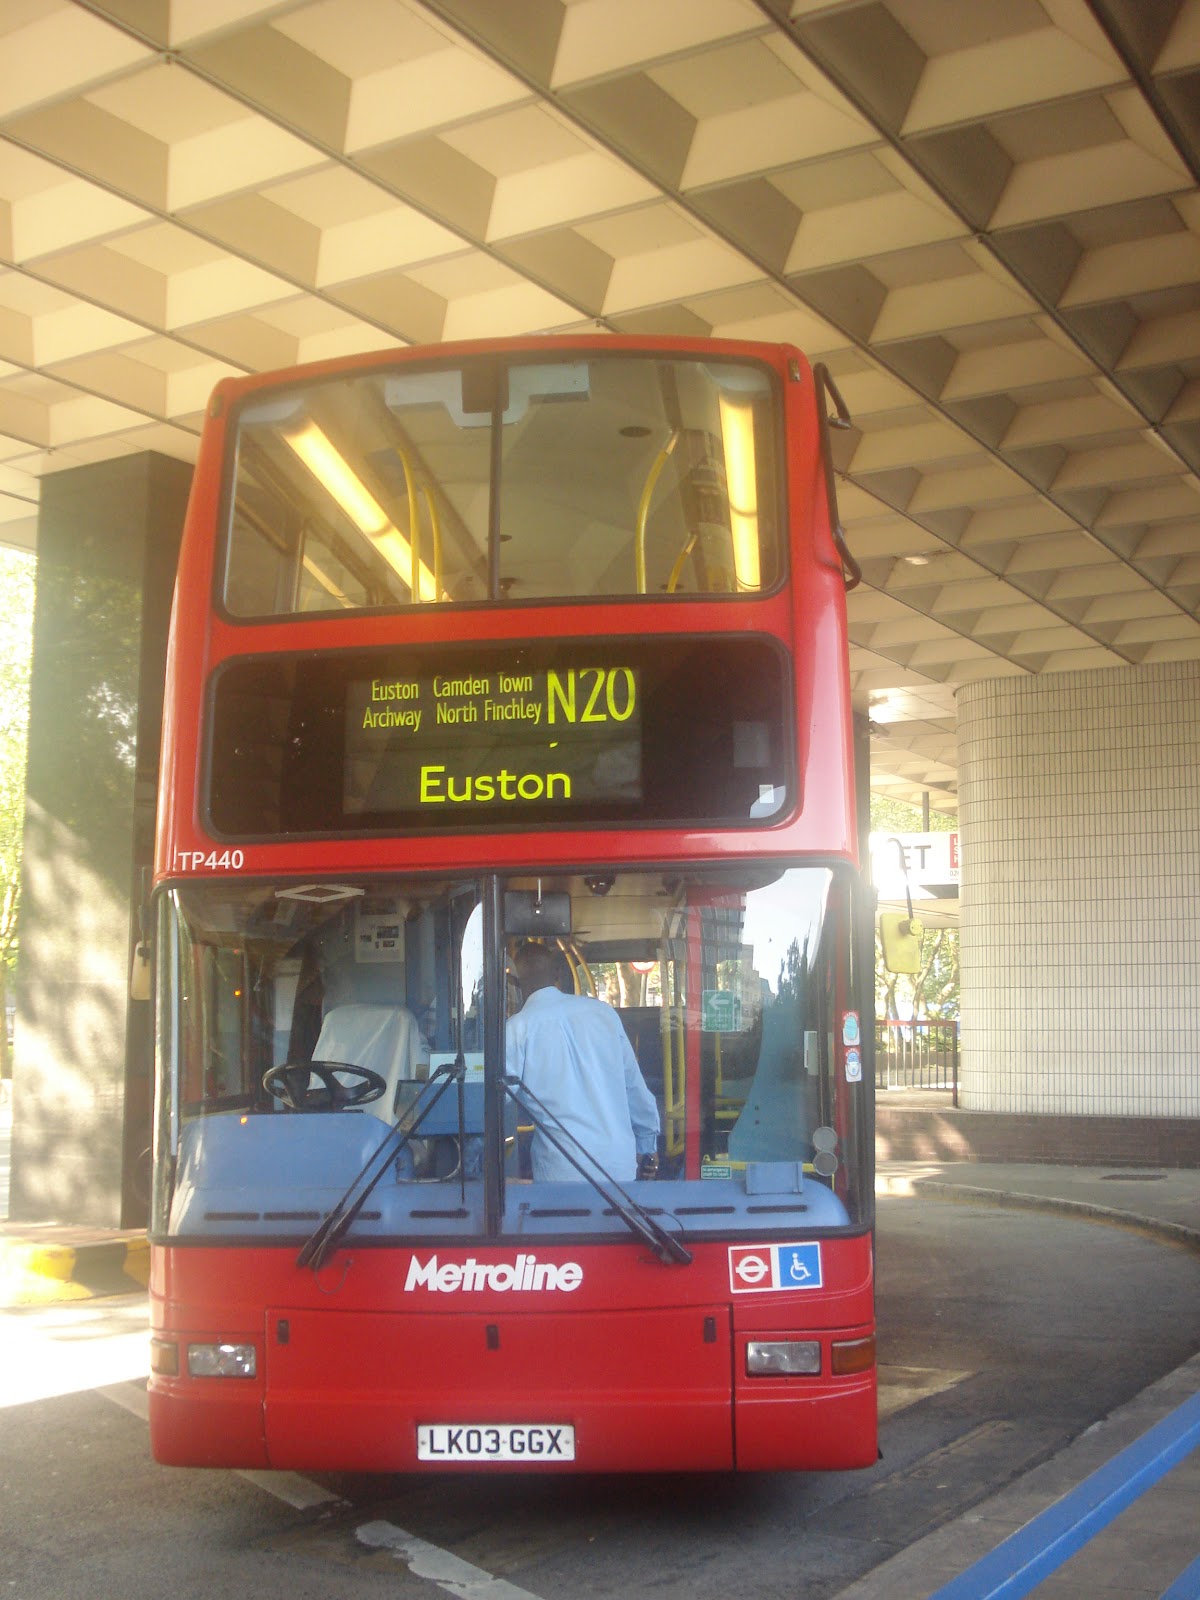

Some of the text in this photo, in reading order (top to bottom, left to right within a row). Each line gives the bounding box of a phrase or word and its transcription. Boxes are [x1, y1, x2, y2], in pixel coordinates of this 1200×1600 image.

[371, 672, 533, 701] Euston Camden Town
[547, 667, 636, 724] N20
[363, 698, 542, 732] Archway North Finchley
[420, 765, 571, 803] Euston
[177, 849, 244, 871] TP440
[403, 1254, 584, 1293] Metroline
[429, 1429, 563, 1455] LK03 GGX
